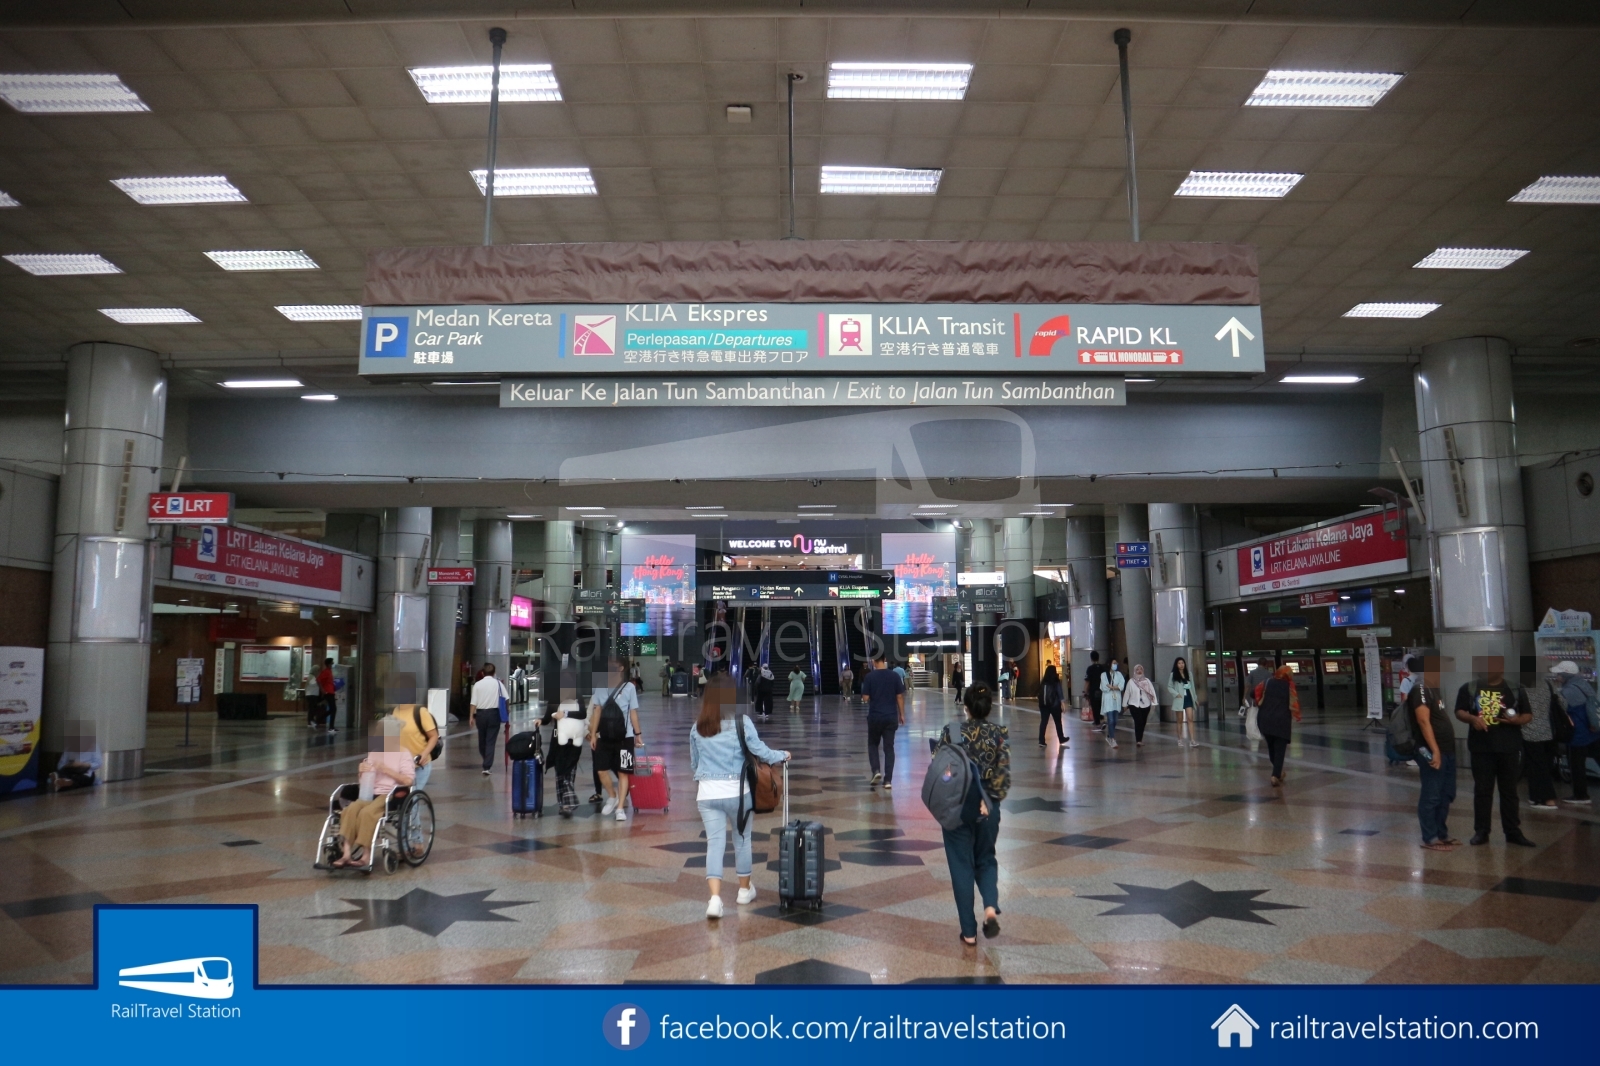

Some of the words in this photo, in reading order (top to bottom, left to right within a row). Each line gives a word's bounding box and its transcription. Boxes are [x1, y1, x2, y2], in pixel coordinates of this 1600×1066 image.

[415, 310, 480, 327] Medan
[488, 310, 553, 327] Kereta
[625, 304, 677, 322] KLIA
[688, 304, 768, 326] Ekspres
[879, 316, 930, 335] KLIA
[938, 316, 1006, 335] Transit
[375, 323, 399, 352] P
[414, 331, 444, 346] Car
[447, 331, 484, 346] Park
[1077, 327, 1143, 345] RAPID
[1150, 327, 1178, 345] KL
[879, 342, 1000, 356] 空港行き普通電車
[413, 350, 454, 364] 駐車場
[623, 350, 809, 364] 空港行き特急電車出発フロア
[1108, 351, 1117, 363] KL
[1118, 351, 1153, 363] MONORAIL
[511, 382, 573, 401] Keluar
[581, 382, 607, 401] Ke
[613, 382, 658, 405] Jalan
[663, 382, 697, 400] Tun
[706, 382, 826, 401] Sambanthan
[847, 382, 881, 400] Exit
[888, 383, 906, 400] to
[911, 382, 957, 405] Jalan
[963, 382, 994, 400] Tun
[1002, 382, 1115, 400] Sambanthan
[185, 499, 213, 512] LRT
[729, 540, 776, 548] WELCOME
[778, 540, 791, 548] TO
[814, 539, 827, 547] nu
[1271, 541, 1285, 558] LRT
[1287, 534, 1314, 553] Laluan
[1316, 528, 1347, 546] Kelana
[1350, 522, 1373, 542] Jaya
[227, 530, 247, 549] LRT
[248, 536, 278, 557] Laluan
[279, 543, 305, 563] Kelana
[307, 550, 325, 569] Jaya
[813, 544, 847, 554] sentral
[226, 553, 241, 567] LRT
[241, 557, 268, 572] KELANA
[269, 561, 285, 575] JAYA
[285, 564, 299, 579] LINE
[1270, 560, 1282, 574] LRT
[1283, 555, 1308, 572] KELANA
[1308, 552, 1323, 568] JAYA
[1325, 550, 1341, 565] LINE
[633, 566, 659, 580] Hong
[660, 566, 685, 580] Kong
[894, 564, 920, 579] Hong
[920, 565, 945, 579] Kong
[588, 590, 603, 598] loft
[983, 588, 998, 596] loft
